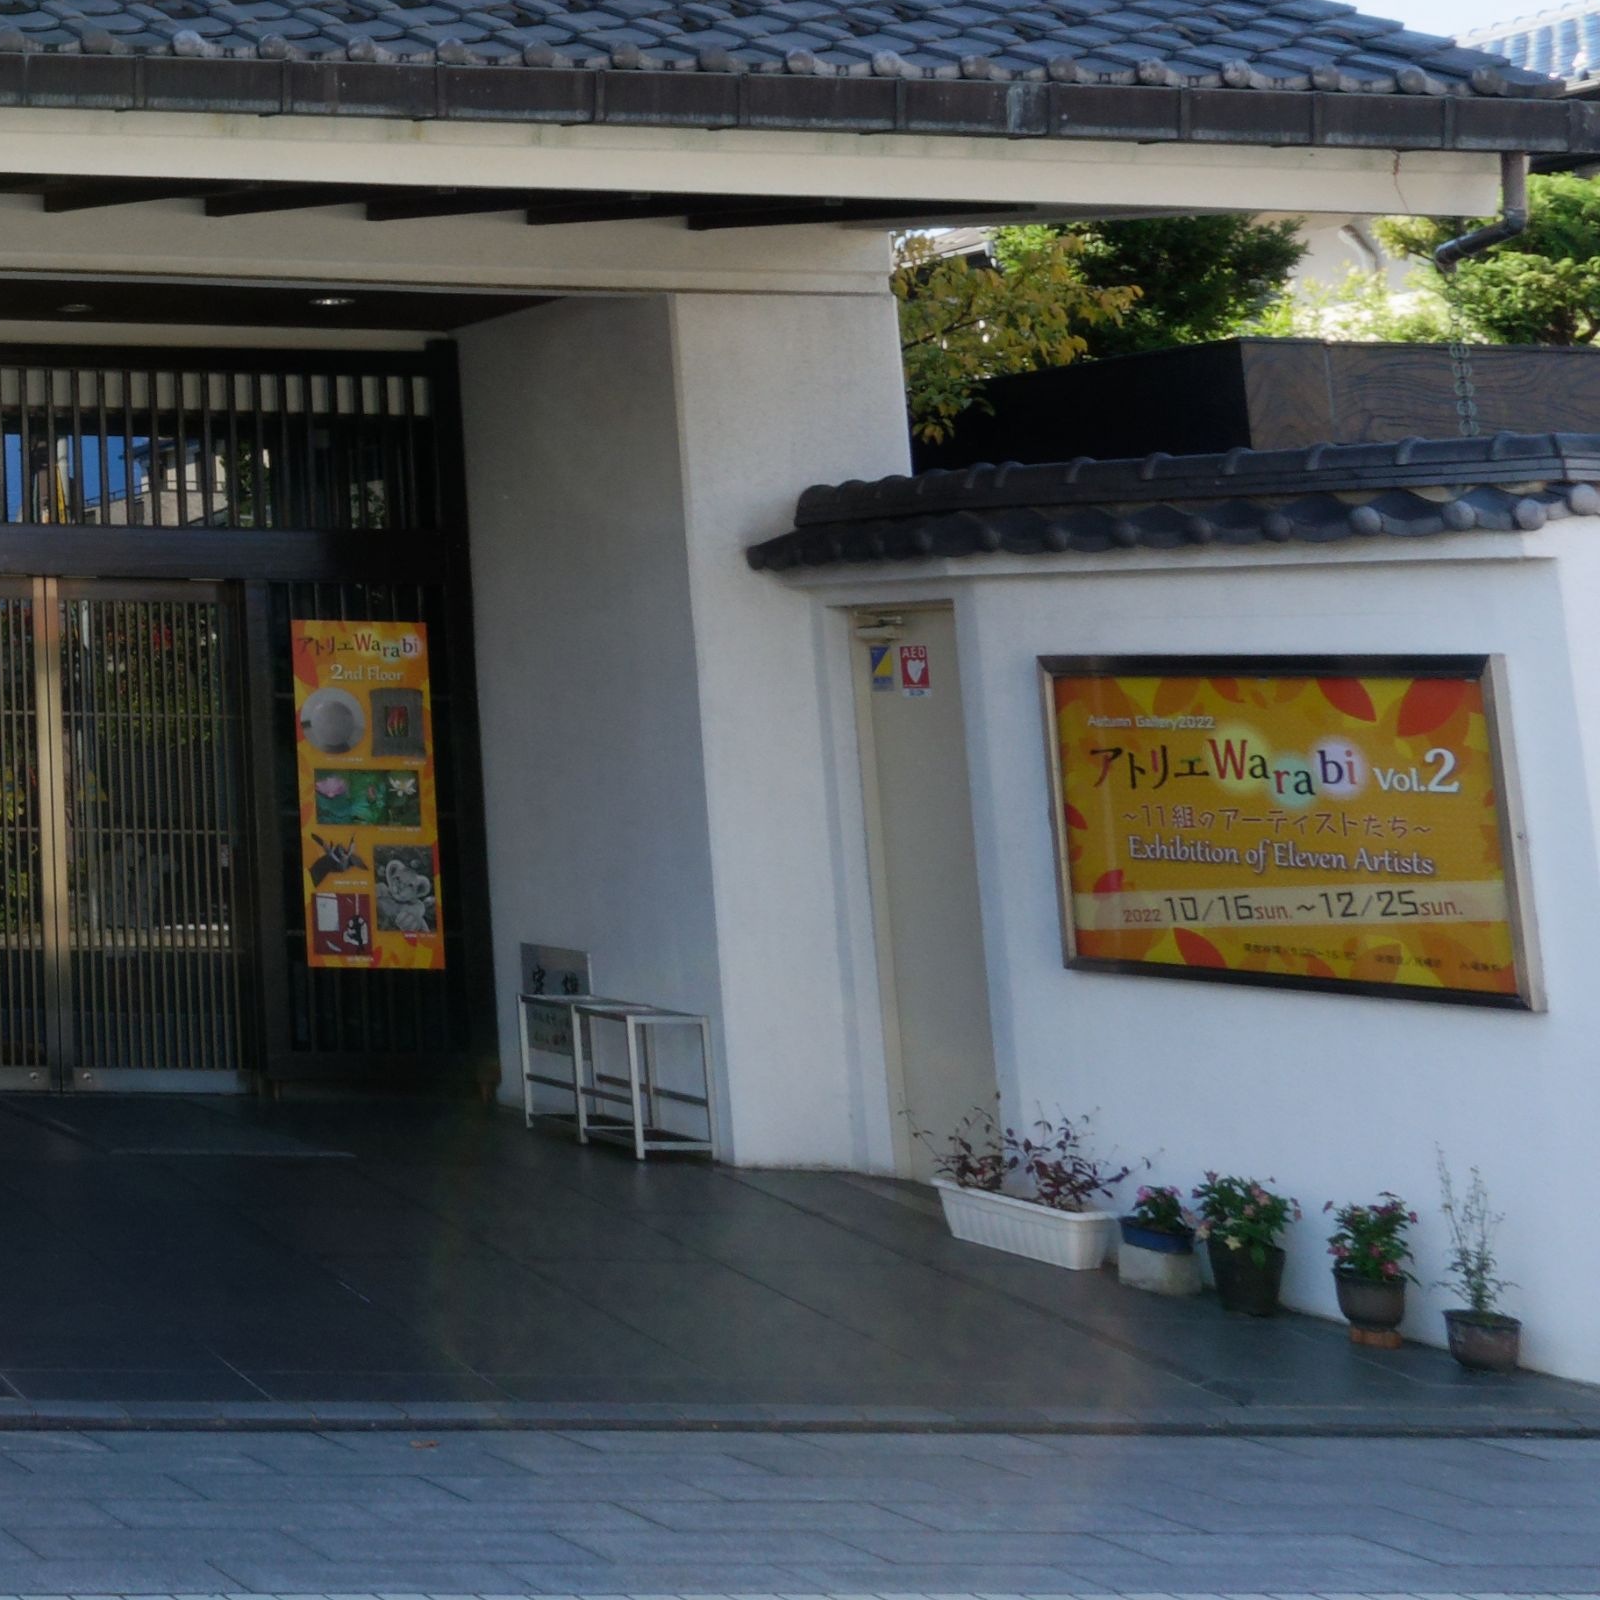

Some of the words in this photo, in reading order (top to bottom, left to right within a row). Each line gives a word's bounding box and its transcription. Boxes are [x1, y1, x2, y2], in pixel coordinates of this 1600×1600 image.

[902, 647, 926, 658] AED
[330, 663, 363, 681] 2nd
[367, 666, 404, 681] Floor
[1372, 748, 1460, 793] Vol.2
[1129, 835, 1240, 865] Exhibition
[1245, 841, 1268, 874] of
[1273, 843, 1347, 870] Eleven
[1353, 850, 1435, 875] Artists
[1122, 908, 1163, 923] 2022
